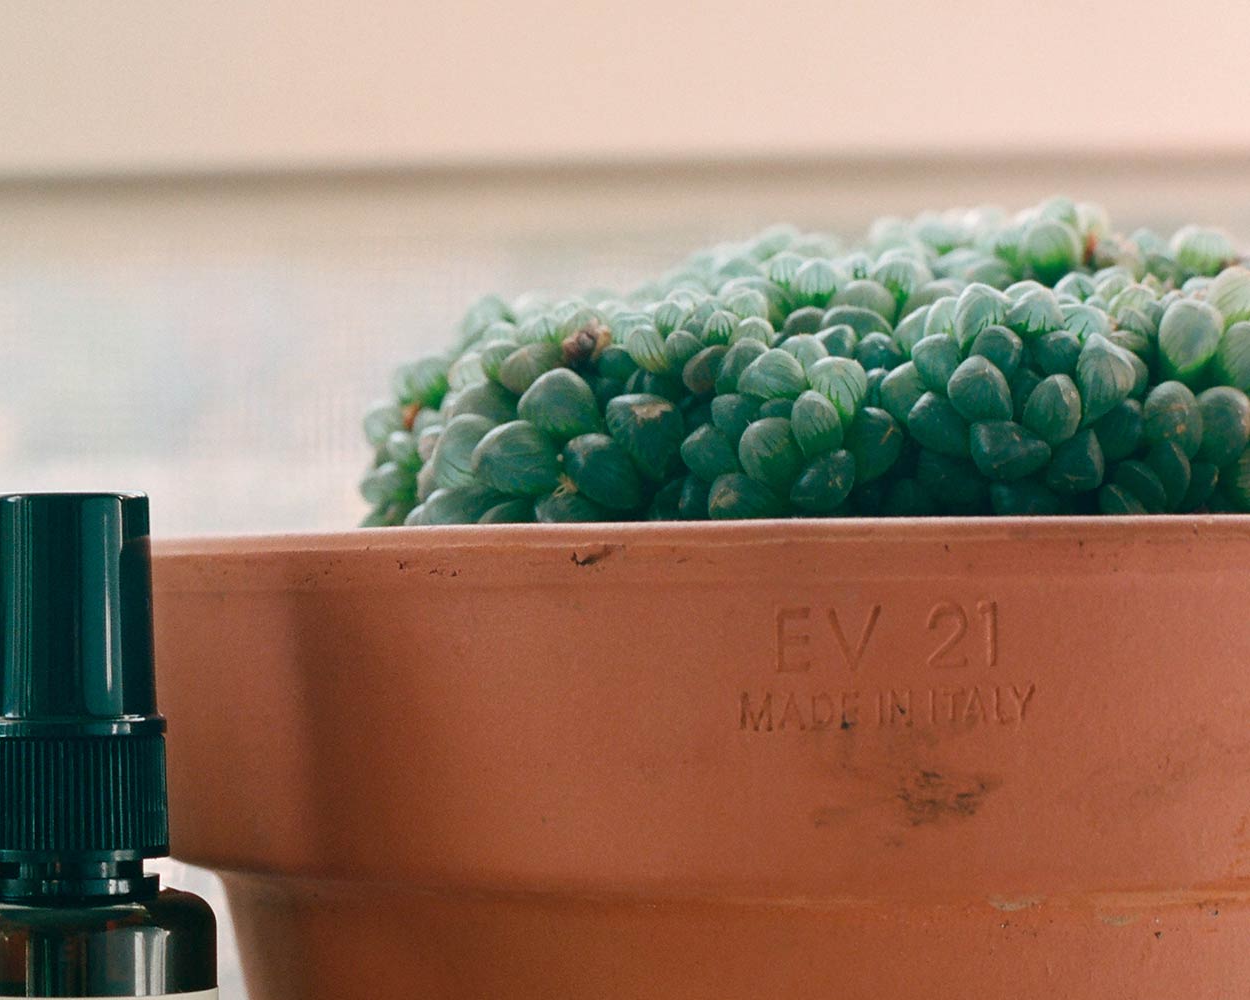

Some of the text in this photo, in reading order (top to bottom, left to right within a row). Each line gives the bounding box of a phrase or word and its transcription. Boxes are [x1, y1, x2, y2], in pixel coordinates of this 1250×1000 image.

[775, 601, 999, 672] EV 21
[739, 683, 1036, 732] MADE IN ITALY
